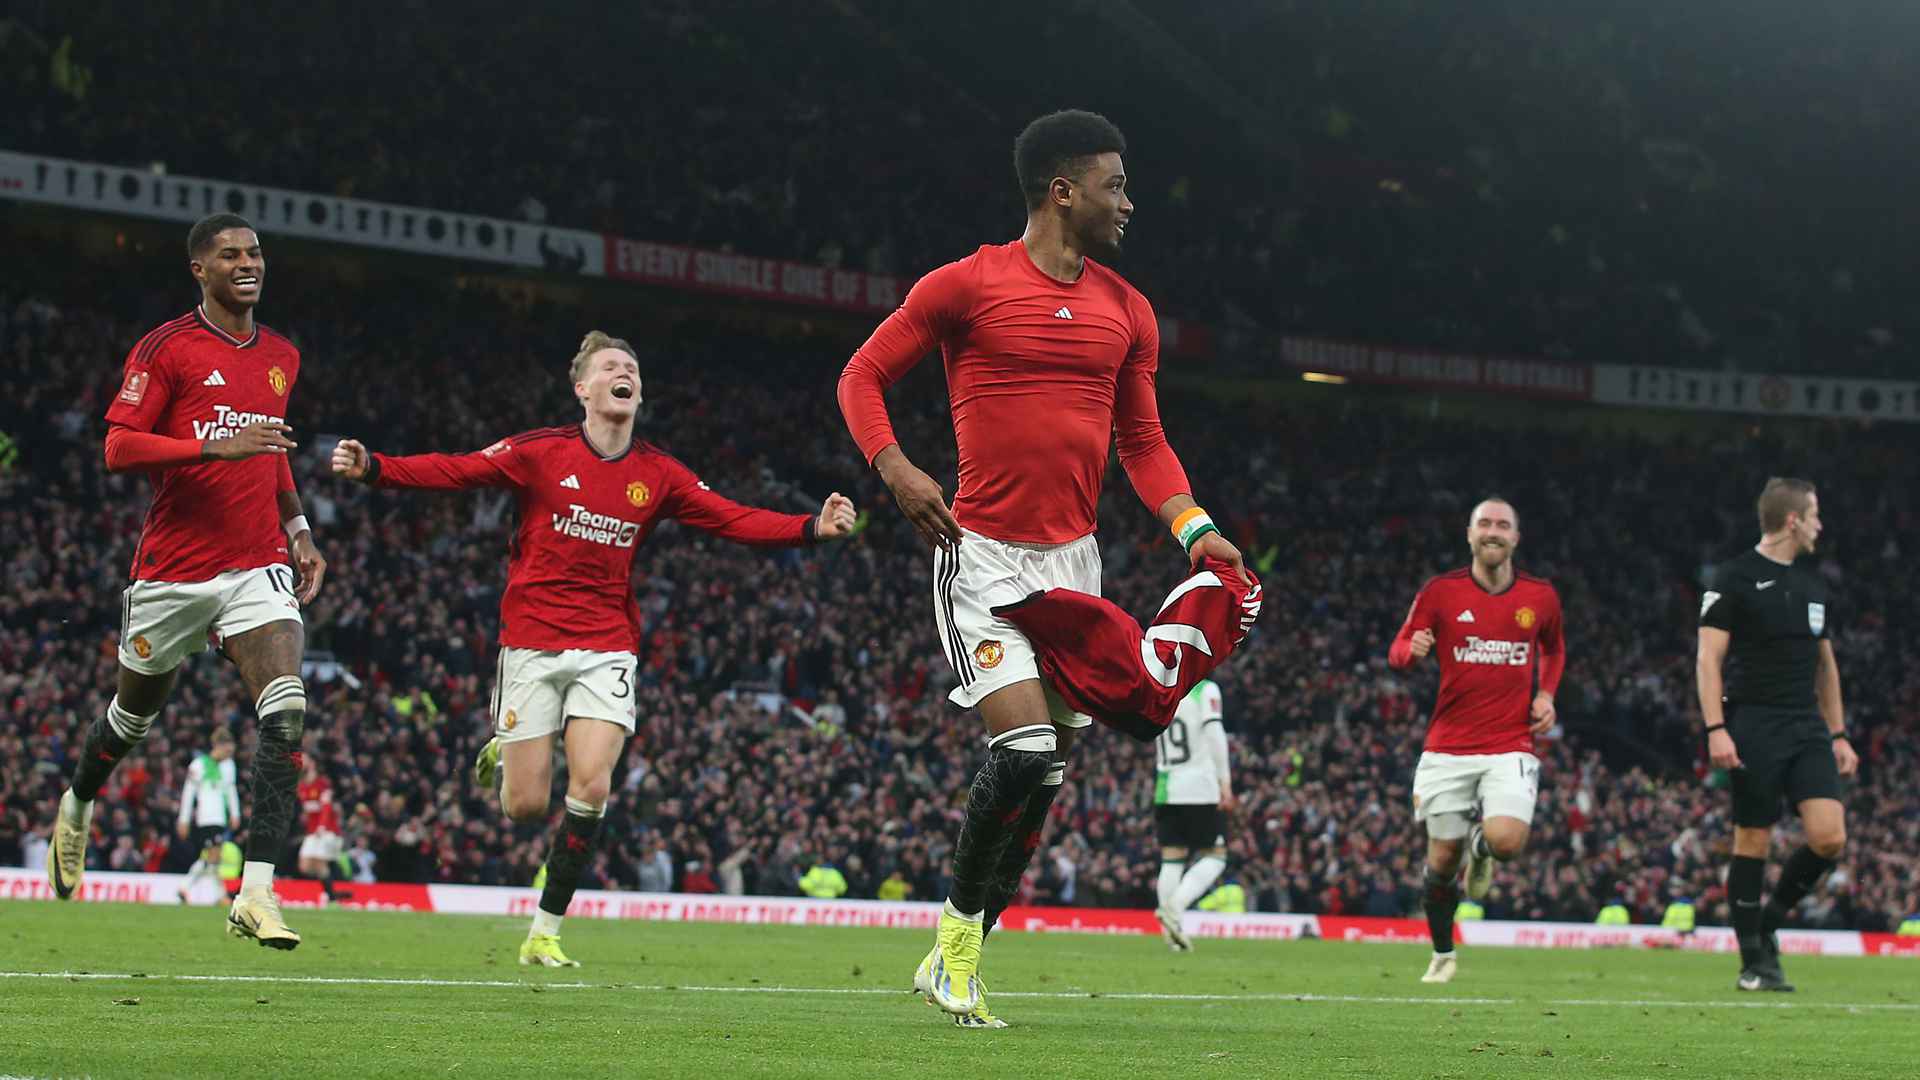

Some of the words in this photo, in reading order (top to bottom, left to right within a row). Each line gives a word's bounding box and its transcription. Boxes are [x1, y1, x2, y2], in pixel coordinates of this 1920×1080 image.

[617, 239, 688, 279] EVERY
[695, 250, 777, 293] SINGLE
[782, 262, 826, 300] ONE
[832, 270, 859, 304] OF
[866, 275, 897, 309] US
[553, 513, 617, 545] Viewer
[569, 504, 621, 532] Team
[1453, 646, 1510, 665] Viewer
[1465, 636, 1512, 652] Team
[1160, 716, 1191, 766] 19
